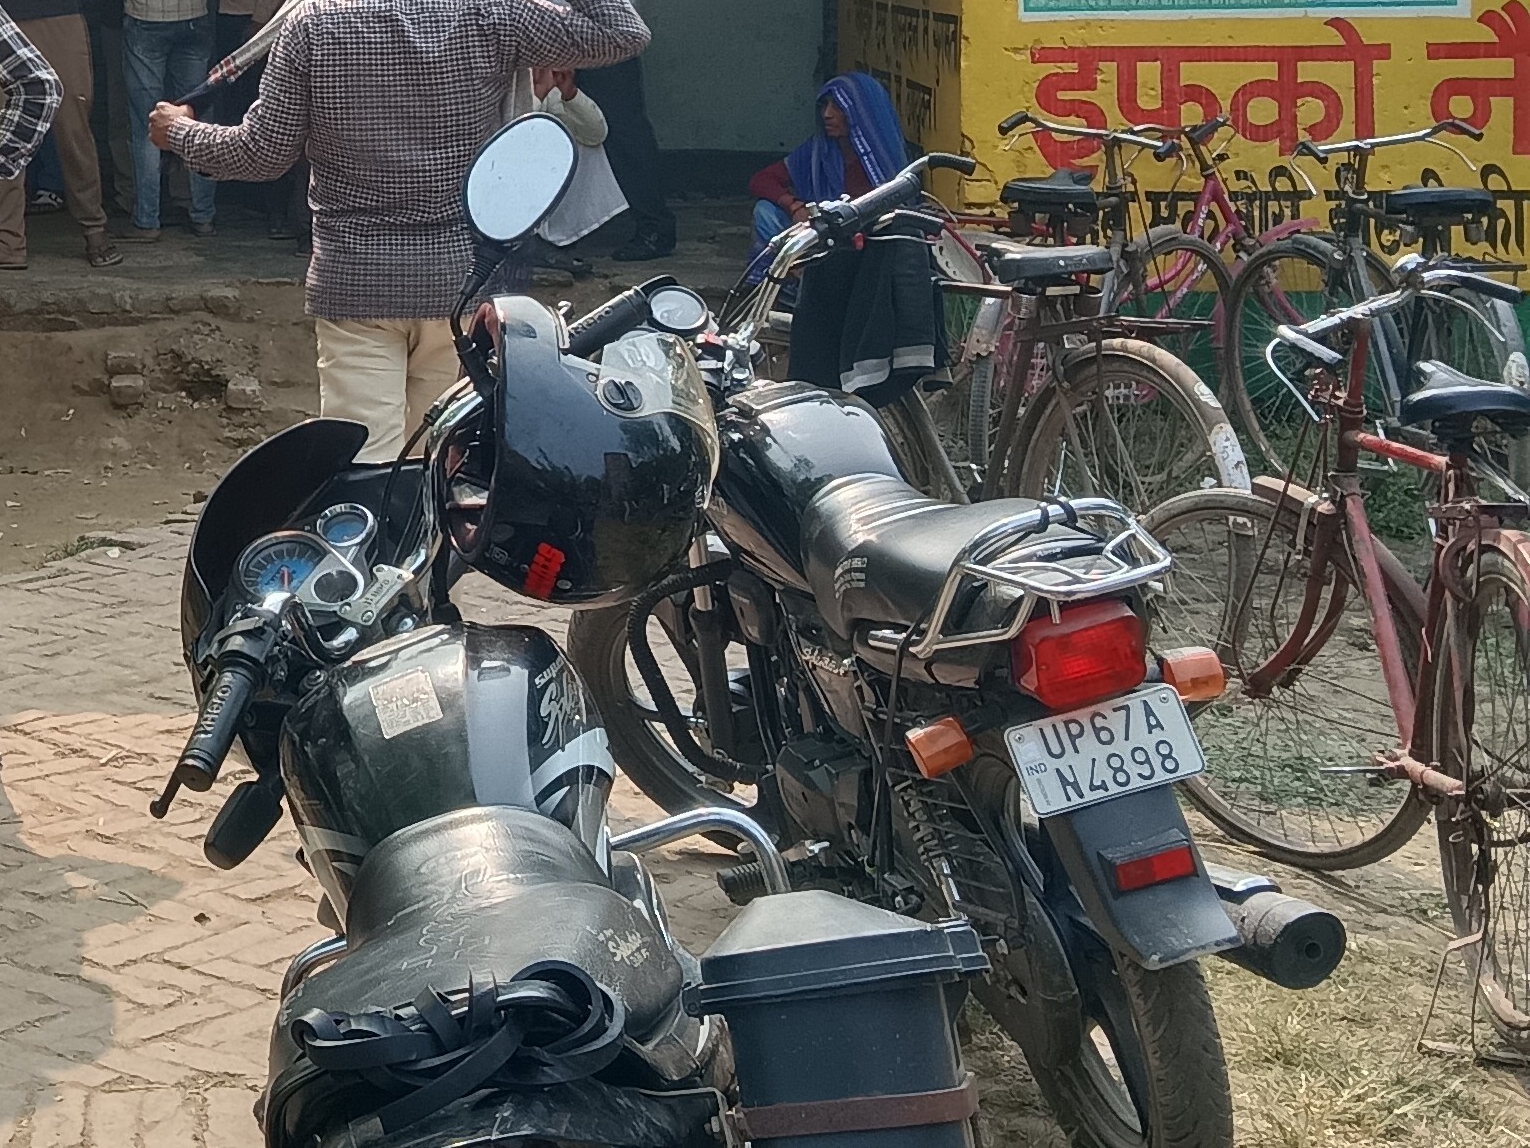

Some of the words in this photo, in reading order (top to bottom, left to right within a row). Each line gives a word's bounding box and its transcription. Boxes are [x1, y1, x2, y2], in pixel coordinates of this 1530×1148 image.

[1038, 699, 1165, 760] UP67A
[1024, 762, 1048, 776] IND
[1055, 739, 1180, 802] N4898
